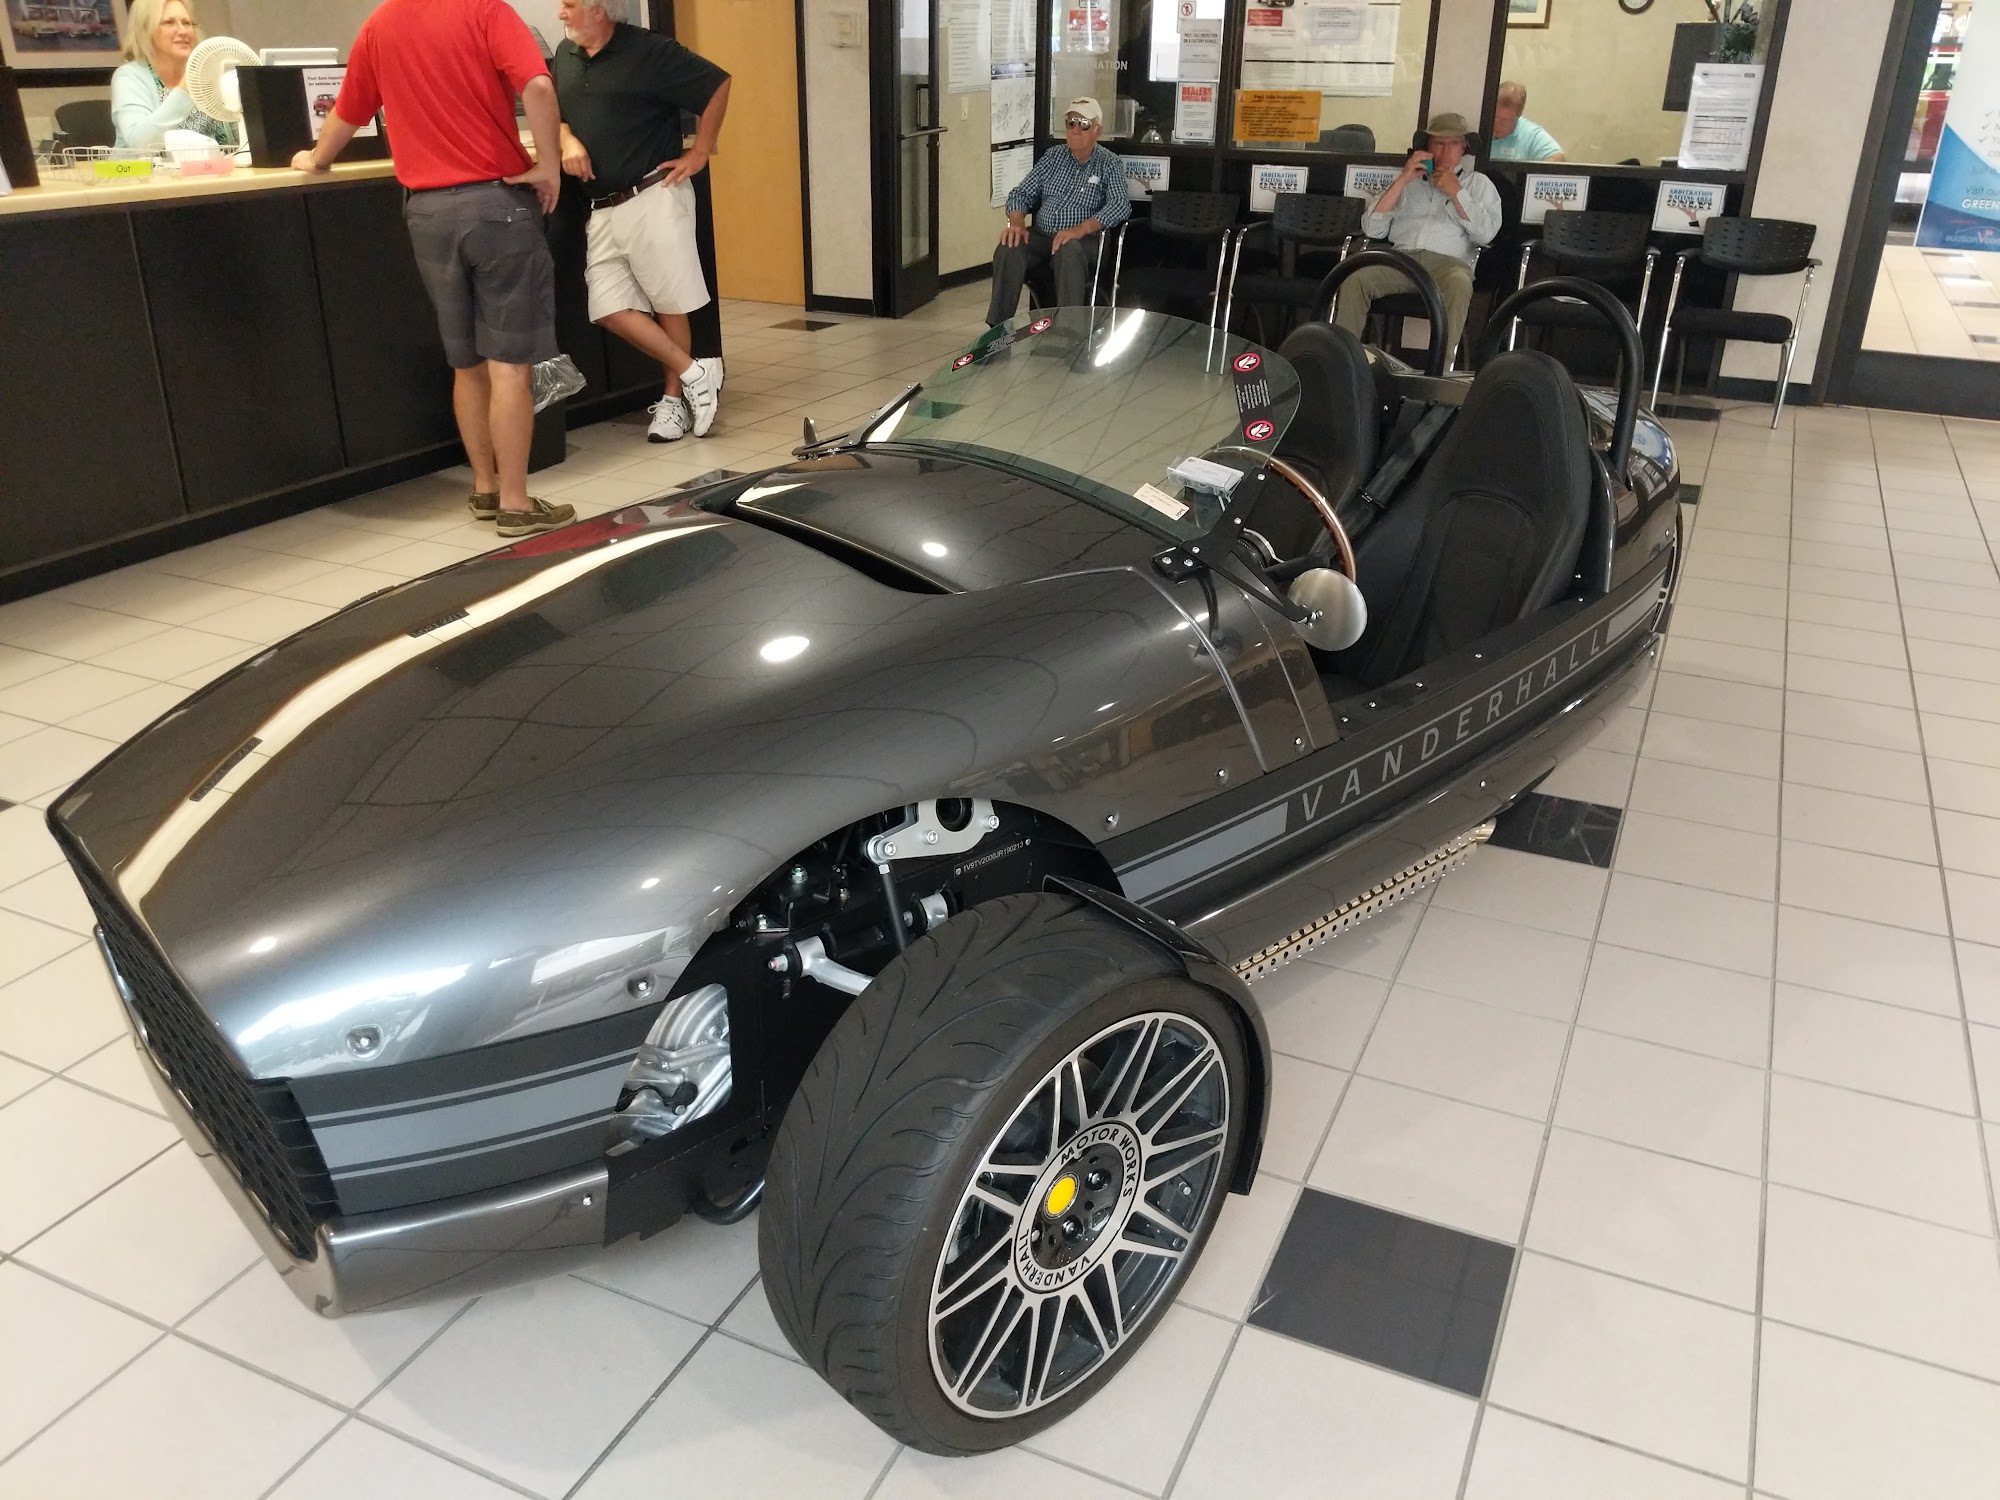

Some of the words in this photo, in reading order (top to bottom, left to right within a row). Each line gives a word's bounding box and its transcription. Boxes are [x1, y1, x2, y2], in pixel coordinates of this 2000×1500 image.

[116, 164, 131, 173] Out
[1669, 188, 1712, 196] ARBITRATION
[1302, 629, 1600, 821] VANDERHALL
[963, 841, 1024, 872] 1V9TV2000JR190213
[1060, 1127, 1120, 1165] MOTOR
[1118, 1133, 1137, 1198] WORKS
[1019, 1228, 1090, 1287] VANDERHALL
